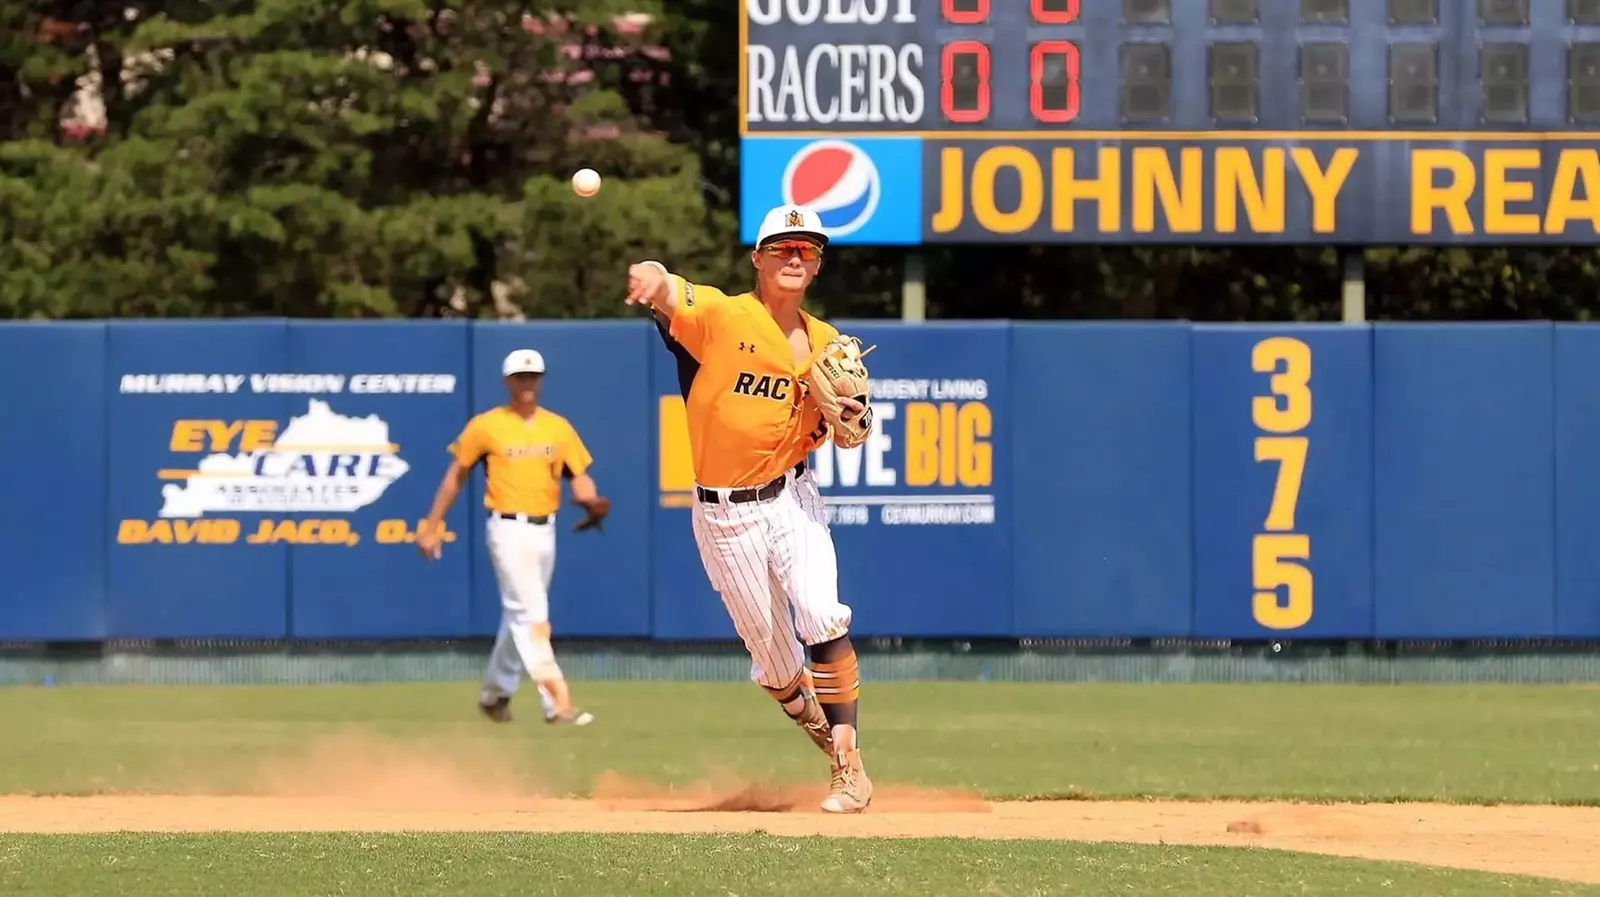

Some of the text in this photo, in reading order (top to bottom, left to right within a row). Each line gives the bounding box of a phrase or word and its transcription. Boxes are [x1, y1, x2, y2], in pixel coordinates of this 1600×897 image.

[745, 41, 1080, 123] RACERS 0 0
[932, 146, 1600, 234] JOHNNY REA
[120, 374, 456, 393] MURRAY VISION CENTER
[733, 371, 810, 401] RAC
[867, 378, 988, 399] TUDENT LIVING
[169, 420, 278, 452] EYE
[809, 402, 992, 487] IVE BIG
[254, 451, 402, 477] CARE
[1252, 337, 1312, 629] 375
[117, 519, 240, 543] DAVID
